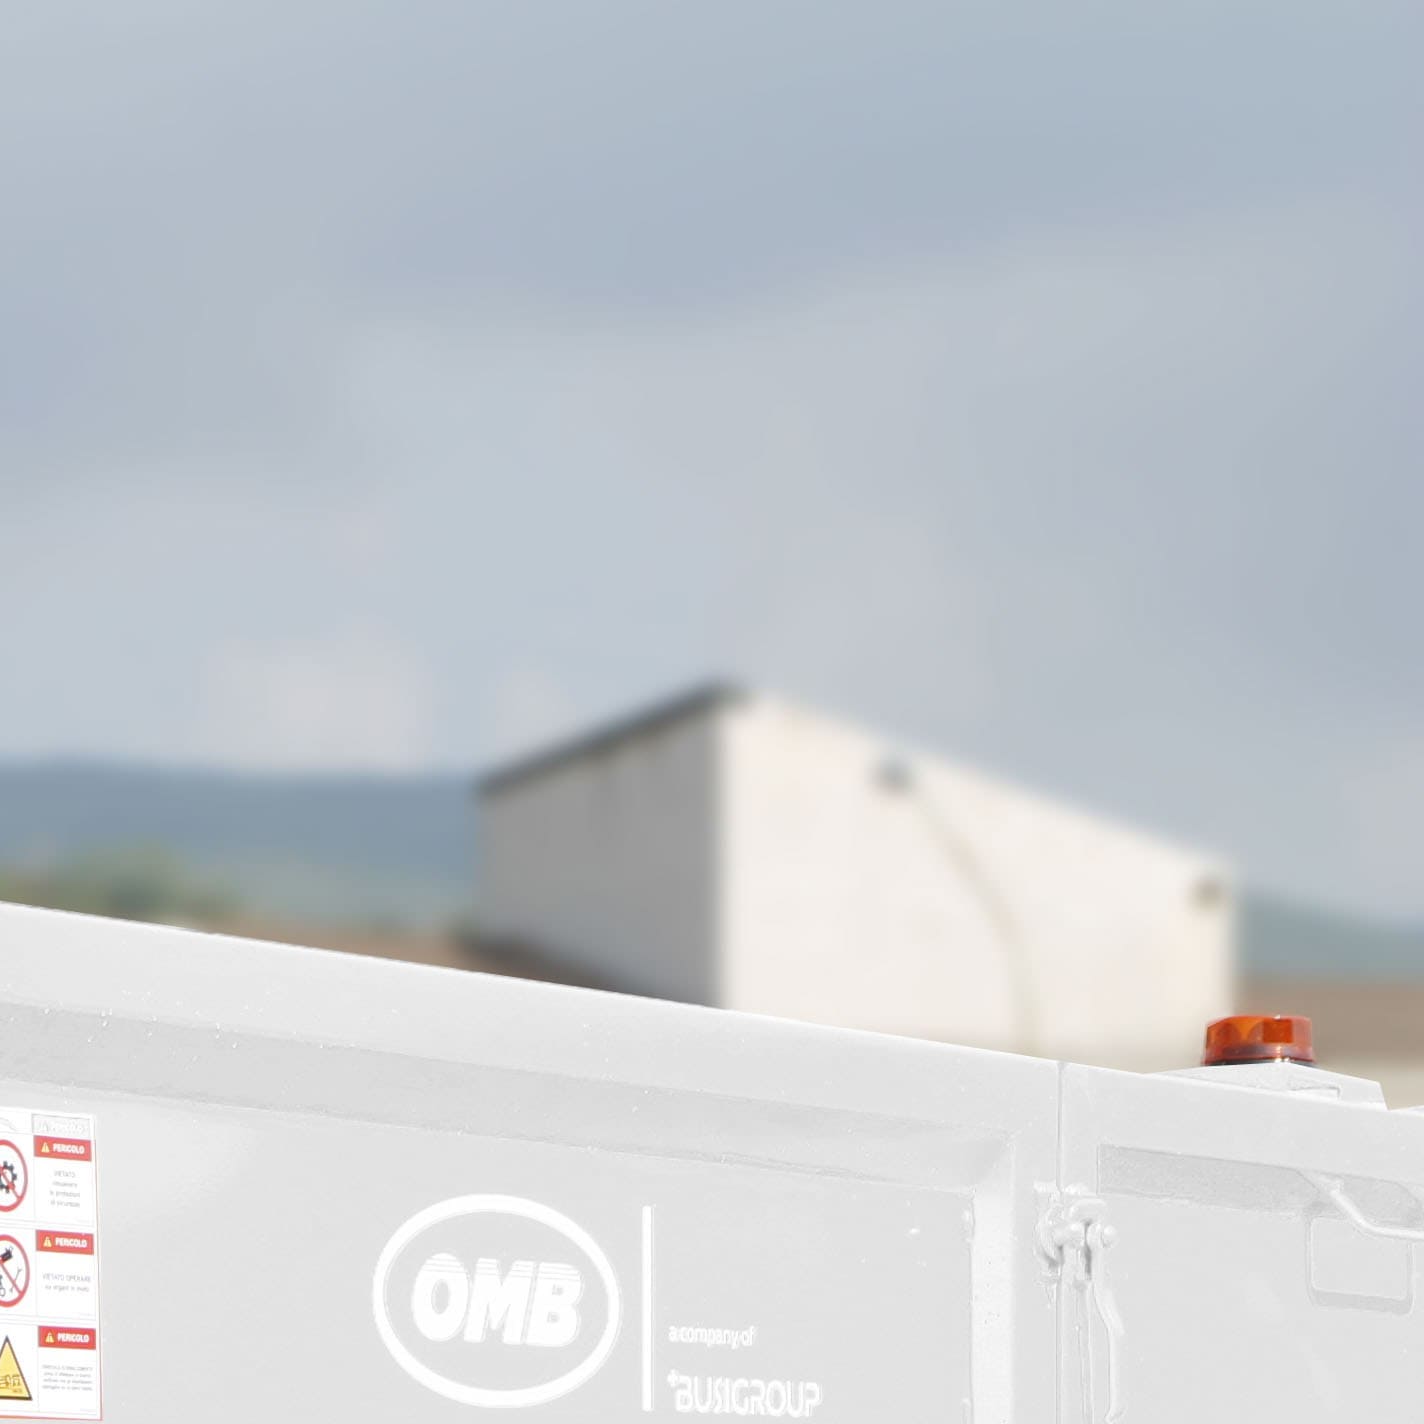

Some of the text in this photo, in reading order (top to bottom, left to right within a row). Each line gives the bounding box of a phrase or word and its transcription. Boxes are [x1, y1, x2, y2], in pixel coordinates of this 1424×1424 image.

[52, 1143, 85, 1154] PERICOLO
[55, 1237, 87, 1248] PERICOLO
[410, 1252, 584, 1348] OMB
[57, 1331, 89, 1343] PERICOLO
